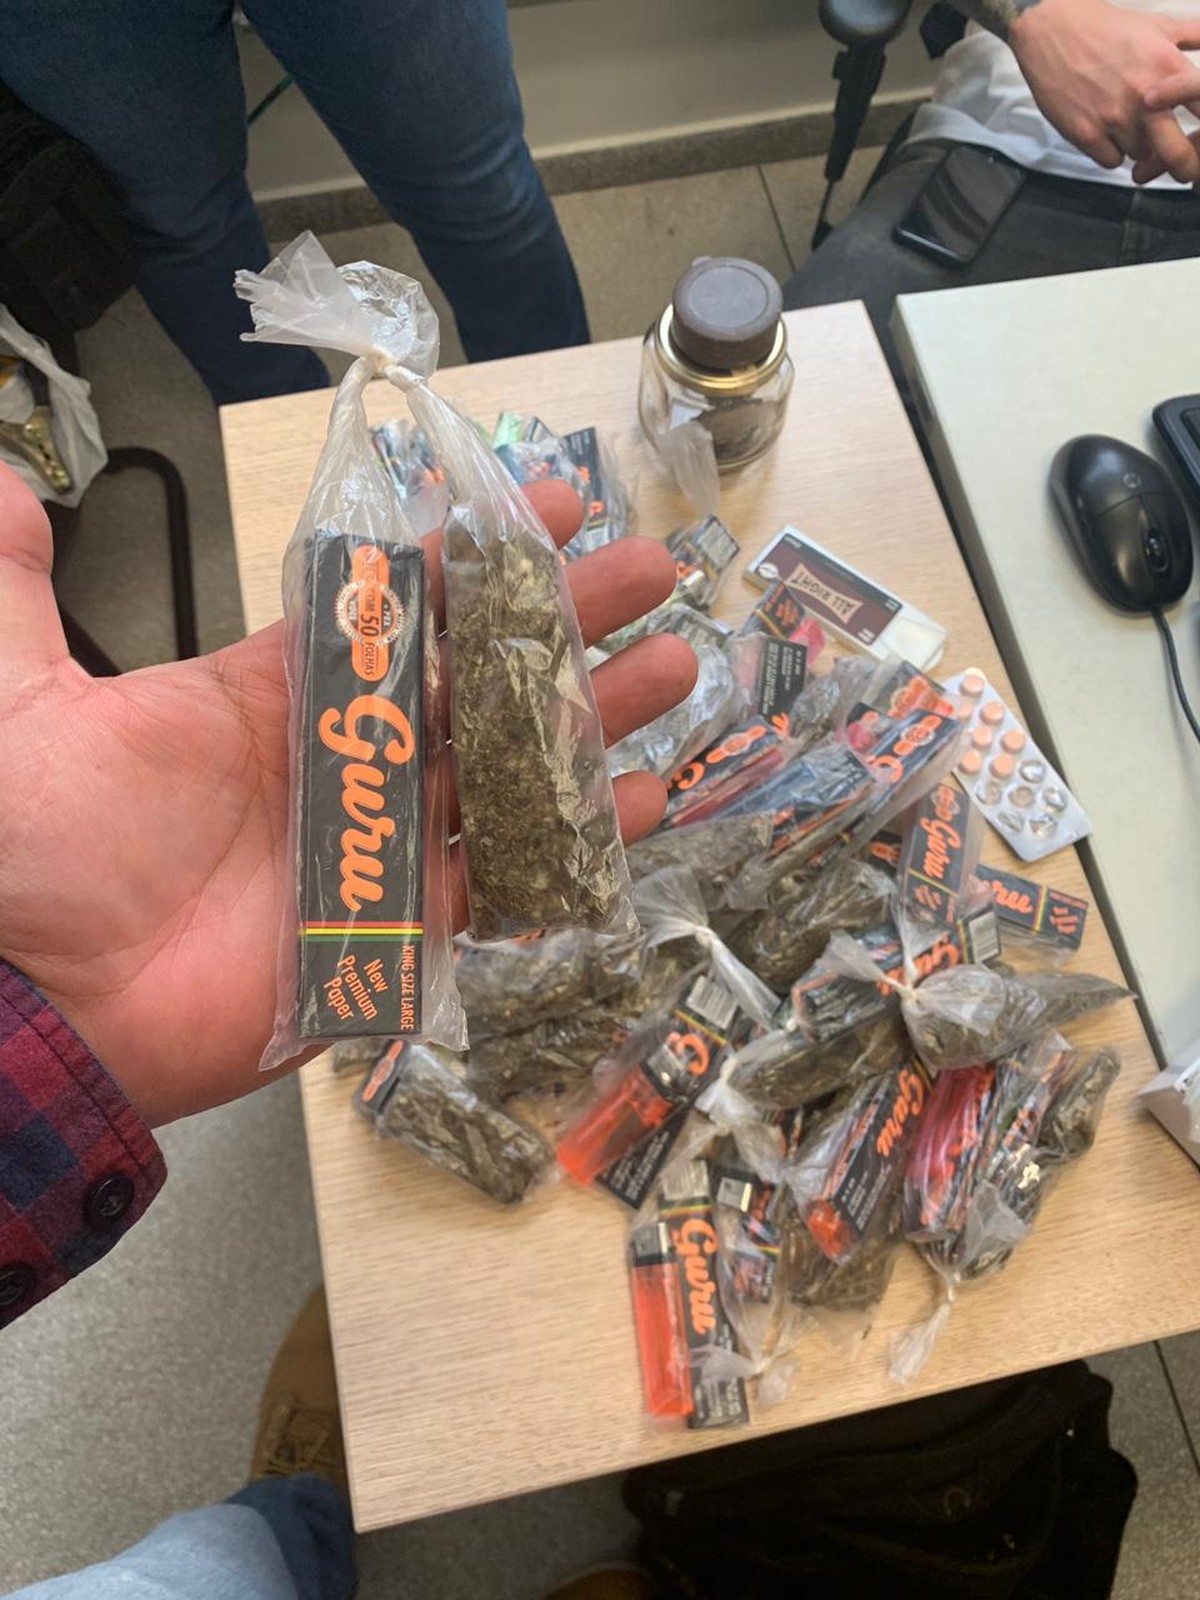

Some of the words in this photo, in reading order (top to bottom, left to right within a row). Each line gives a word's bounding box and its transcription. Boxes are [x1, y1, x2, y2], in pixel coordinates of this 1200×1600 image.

[790, 570, 832, 600] RIGHT
[830, 595, 856, 615] ALL
[360, 613, 380, 637] 50
[364, 641, 375, 676] FOLHAS
[318, 694, 416, 913] Guru
[920, 816, 961, 880] Guru
[363, 958, 389, 993] New
[402, 945, 415, 971] KING
[323, 976, 354, 1020] Paper
[337, 954, 378, 1021] Premium
[401, 973, 415, 995] SIZE
[401, 998, 414, 1031] LARGE
[671, 1218, 718, 1334] Guru
